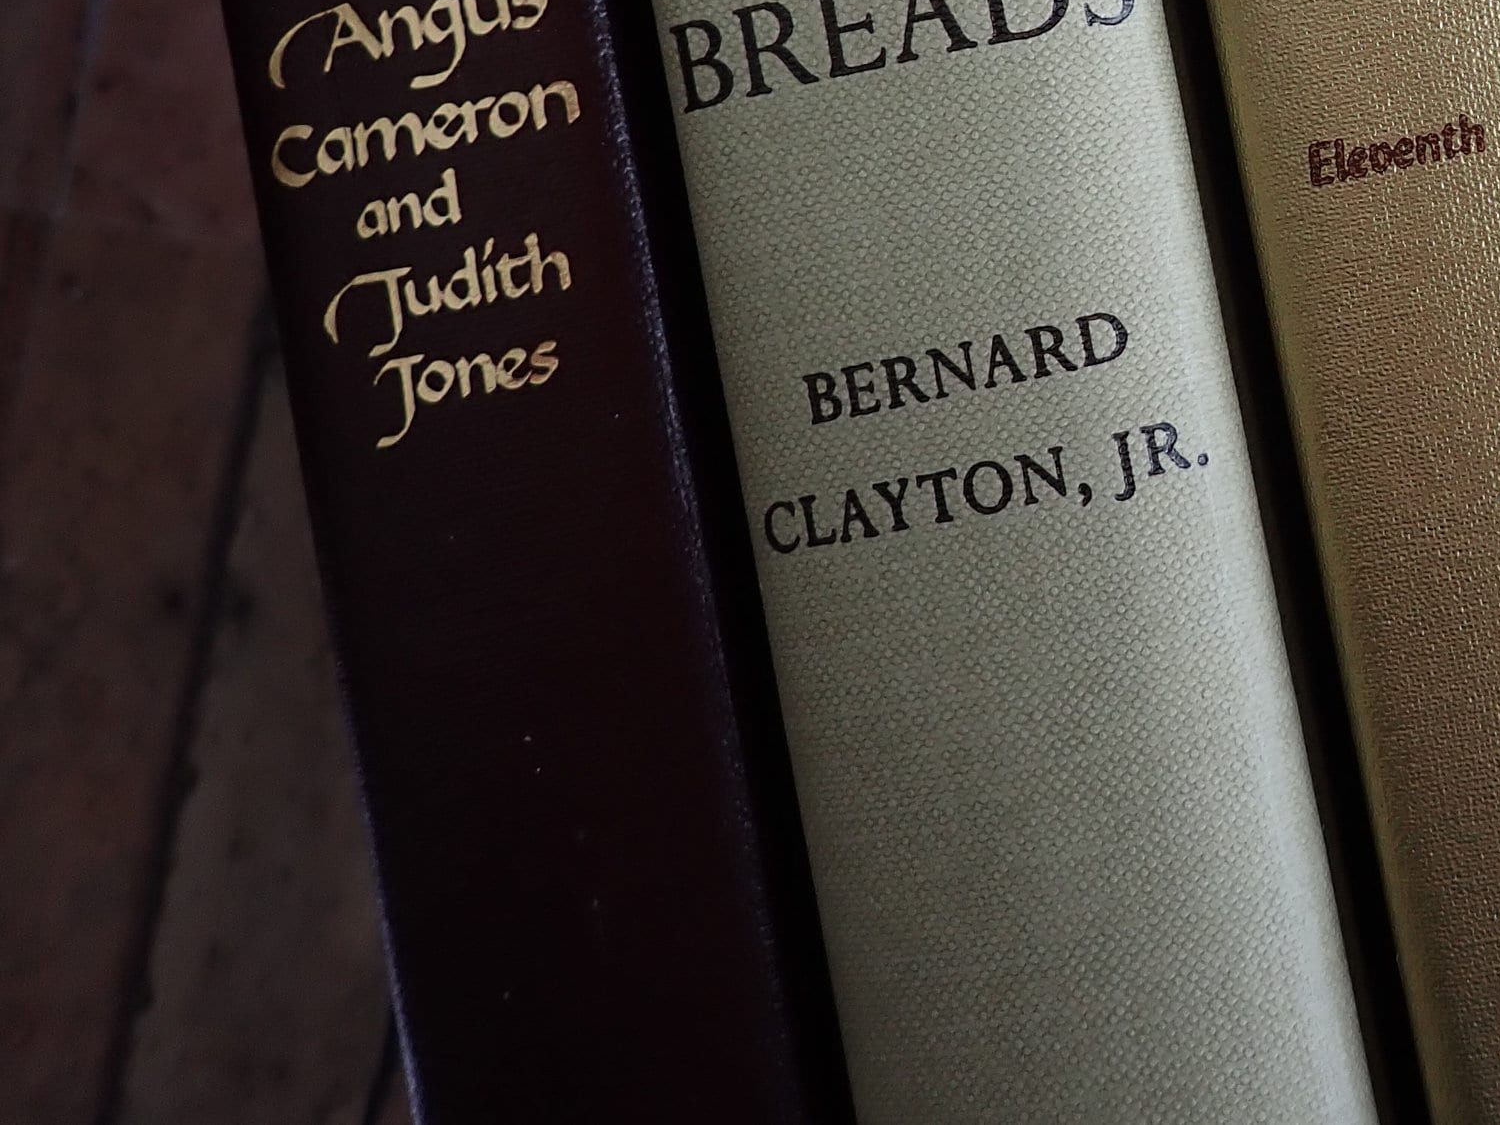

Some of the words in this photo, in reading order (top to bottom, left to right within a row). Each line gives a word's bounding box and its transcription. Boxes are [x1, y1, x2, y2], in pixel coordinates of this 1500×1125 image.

[271, 80, 582, 188] Cameron
[1307, 114, 1486, 187] Eleventh
[356, 168, 463, 239] and
[323, 232, 572, 358] Judith
[373, 340, 560, 449] Jones
[805, 312, 1130, 426] BERNARD
[763, 445, 1094, 555] CLAYTON,
[1113, 421, 1210, 503] JR.
